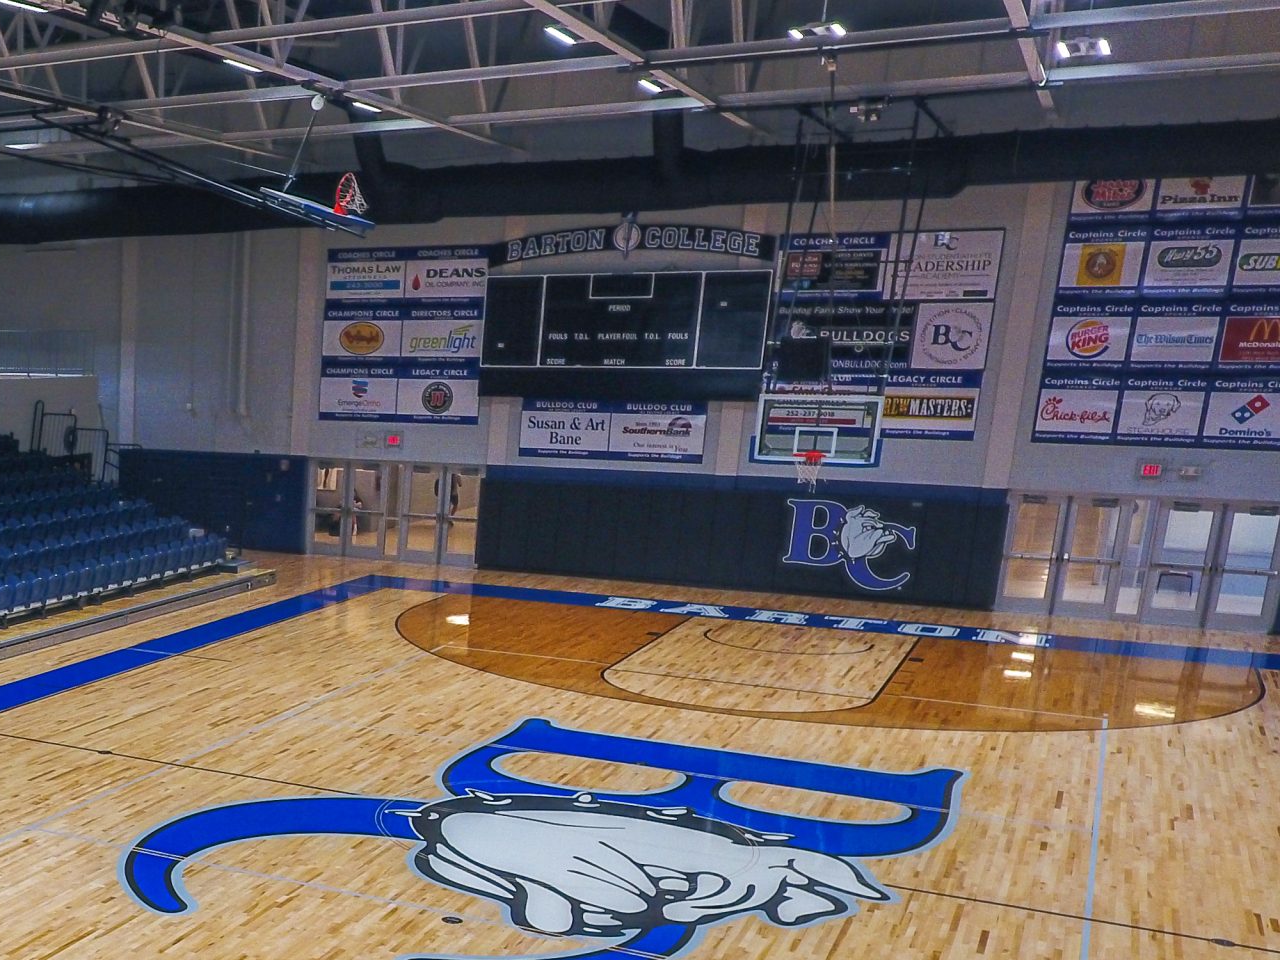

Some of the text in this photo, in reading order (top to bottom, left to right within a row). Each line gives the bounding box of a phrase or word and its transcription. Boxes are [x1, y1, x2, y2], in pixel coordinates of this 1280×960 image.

[1160, 194, 1240, 204] Pizza Inn
[1069, 231, 1114, 239] Captains
[1154, 227, 1236, 237] Captains Circle
[508, 226, 760, 261] BARTON COLLEGE
[843, 236, 876, 245] CIRCLE
[372, 250, 396, 258] CIRCLE
[454, 248, 480, 256] CIRCLE
[898, 260, 992, 272] ADERSHIP
[1243, 256, 1280, 270] SUB
[331, 264, 401, 275] THOMAS LAW
[426, 267, 486, 278] DEANS
[1056, 305, 1102, 313] Captains
[1141, 304, 1188, 312] Captains
[1230, 304, 1280, 312] Captains
[1071, 325, 1109, 340] BURGER
[409, 330, 476, 354] greenlight
[931, 324, 973, 352] BC
[1070, 333, 1110, 350] KING
[1154, 334, 1186, 344] Wilson
[888, 375, 926, 383] LEGACY
[1044, 378, 1089, 386] Captains
[1128, 379, 1208, 387] Captains Circle
[1215, 380, 1264, 388] Captains
[338, 400, 380, 408] EmergeOrtho
[626, 403, 668, 411] BULLDOG
[883, 398, 968, 416] REWMASTERS
[1040, 397, 1110, 424] Chick-fil-A
[528, 416, 606, 432] Susan & Art
[622, 426, 692, 436] SouthernBank
[1219, 428, 1272, 436] Domino's
[549, 432, 582, 446] Bane
[783, 499, 916, 590] BC
[595, 596, 1052, 647] BARTON
